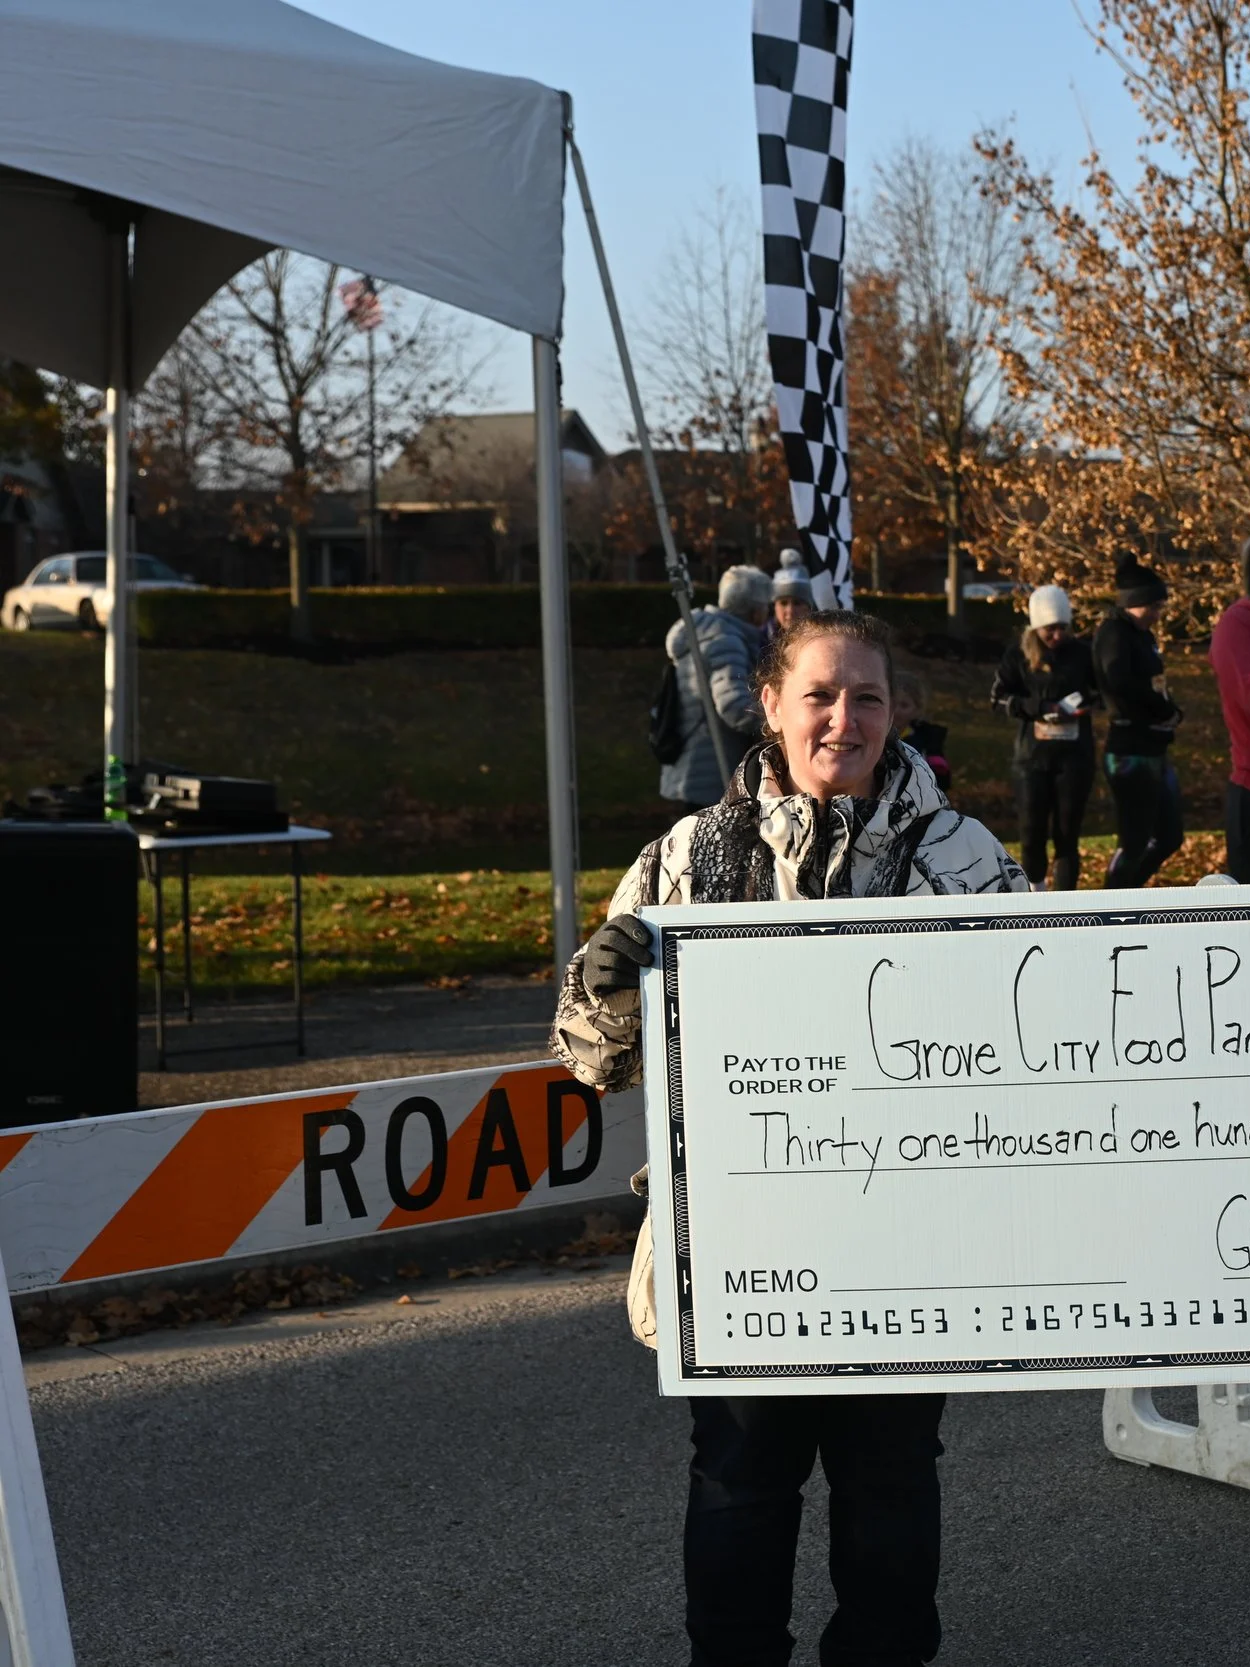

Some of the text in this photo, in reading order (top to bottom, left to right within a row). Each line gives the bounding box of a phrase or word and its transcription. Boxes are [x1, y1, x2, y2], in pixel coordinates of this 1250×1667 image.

[867, 958, 1001, 1081] Grove
[1109, 944, 1187, 1067] Food
[728, 1078, 838, 1095] ORDER OF
[804, 1055, 847, 1071] THE
[303, 1079, 604, 1227] ROAD
[749, 1112, 883, 1195] Thirty
[1130, 1129, 1180, 1155] one
[724, 1269, 819, 1294] MEMO
